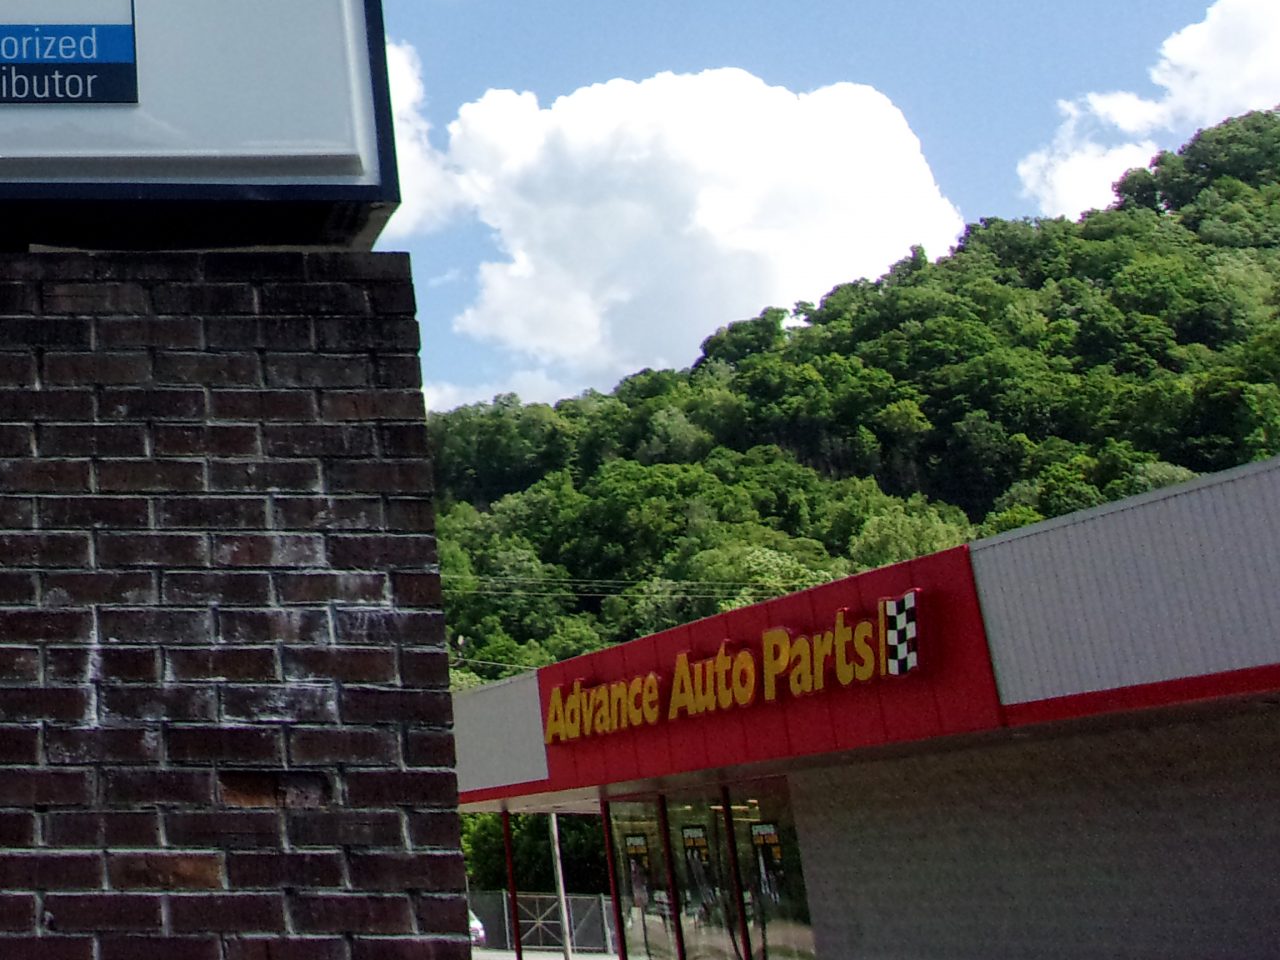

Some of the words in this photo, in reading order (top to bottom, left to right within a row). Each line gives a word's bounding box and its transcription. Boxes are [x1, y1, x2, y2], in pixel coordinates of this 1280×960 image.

[544, 672, 660, 744] Advance
[668, 640, 755, 720] Auto
[762, 607, 876, 702] Parts
